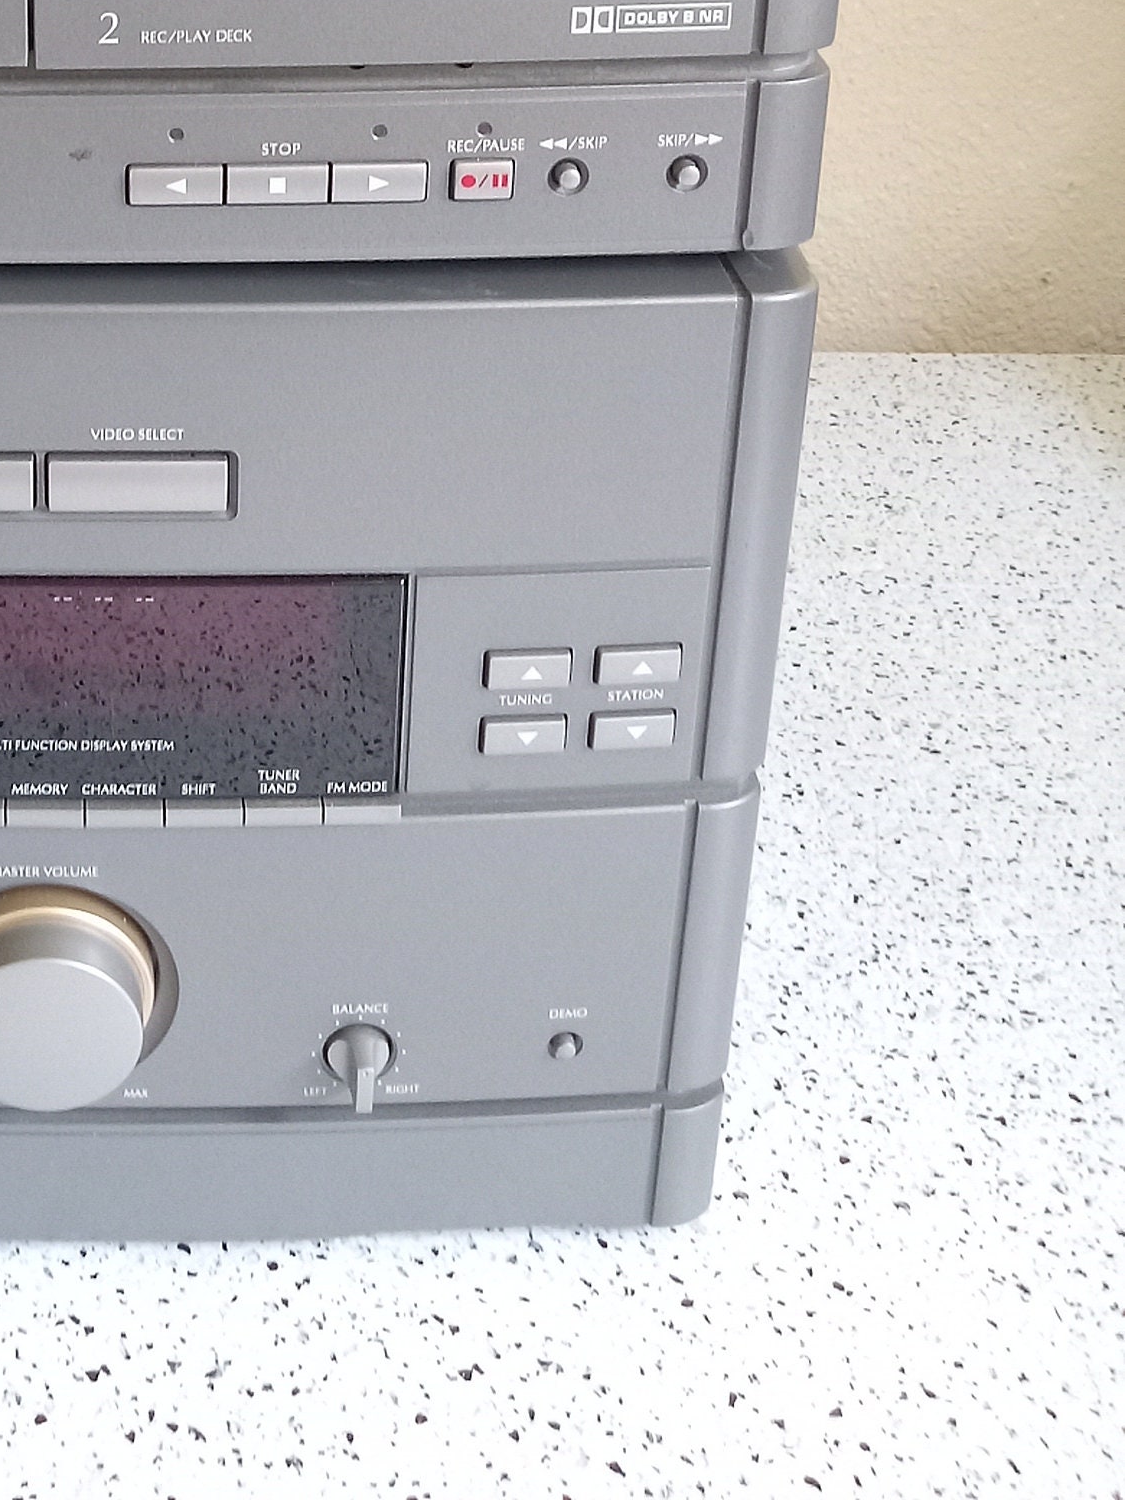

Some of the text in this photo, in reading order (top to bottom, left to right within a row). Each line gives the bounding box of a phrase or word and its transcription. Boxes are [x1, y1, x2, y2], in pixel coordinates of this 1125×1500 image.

[624, 10, 680, 26] DOLBY
[699, 9, 725, 24] NR
[98, 11, 121, 46] 2
[140, 28, 254, 45] REC/PLAY DECK
[261, 142, 302, 157] STOP
[447, 137, 526, 153] REC/PAUSE
[90, 427, 184, 441] VIDEO SELECT
[499, 693, 552, 706] TUNING
[607, 689, 664, 701] STATION
[15, 739, 77, 752] FUNCTION
[80, 740, 127, 752] DISPLAY
[130, 740, 175, 751] SYSTEM
[258, 769, 300, 781] TUNER
[11, 783, 68, 796] MEMORY
[81, 783, 157, 796] CHARACTER
[181, 783, 216, 796] SHIFT
[260, 782, 297, 794] BAND
[327, 780, 389, 793] FM MODE
[43, 866, 99, 878] VOLUME
[332, 1003, 389, 1015] BALANCE
[549, 1007, 588, 1020] DEMO
